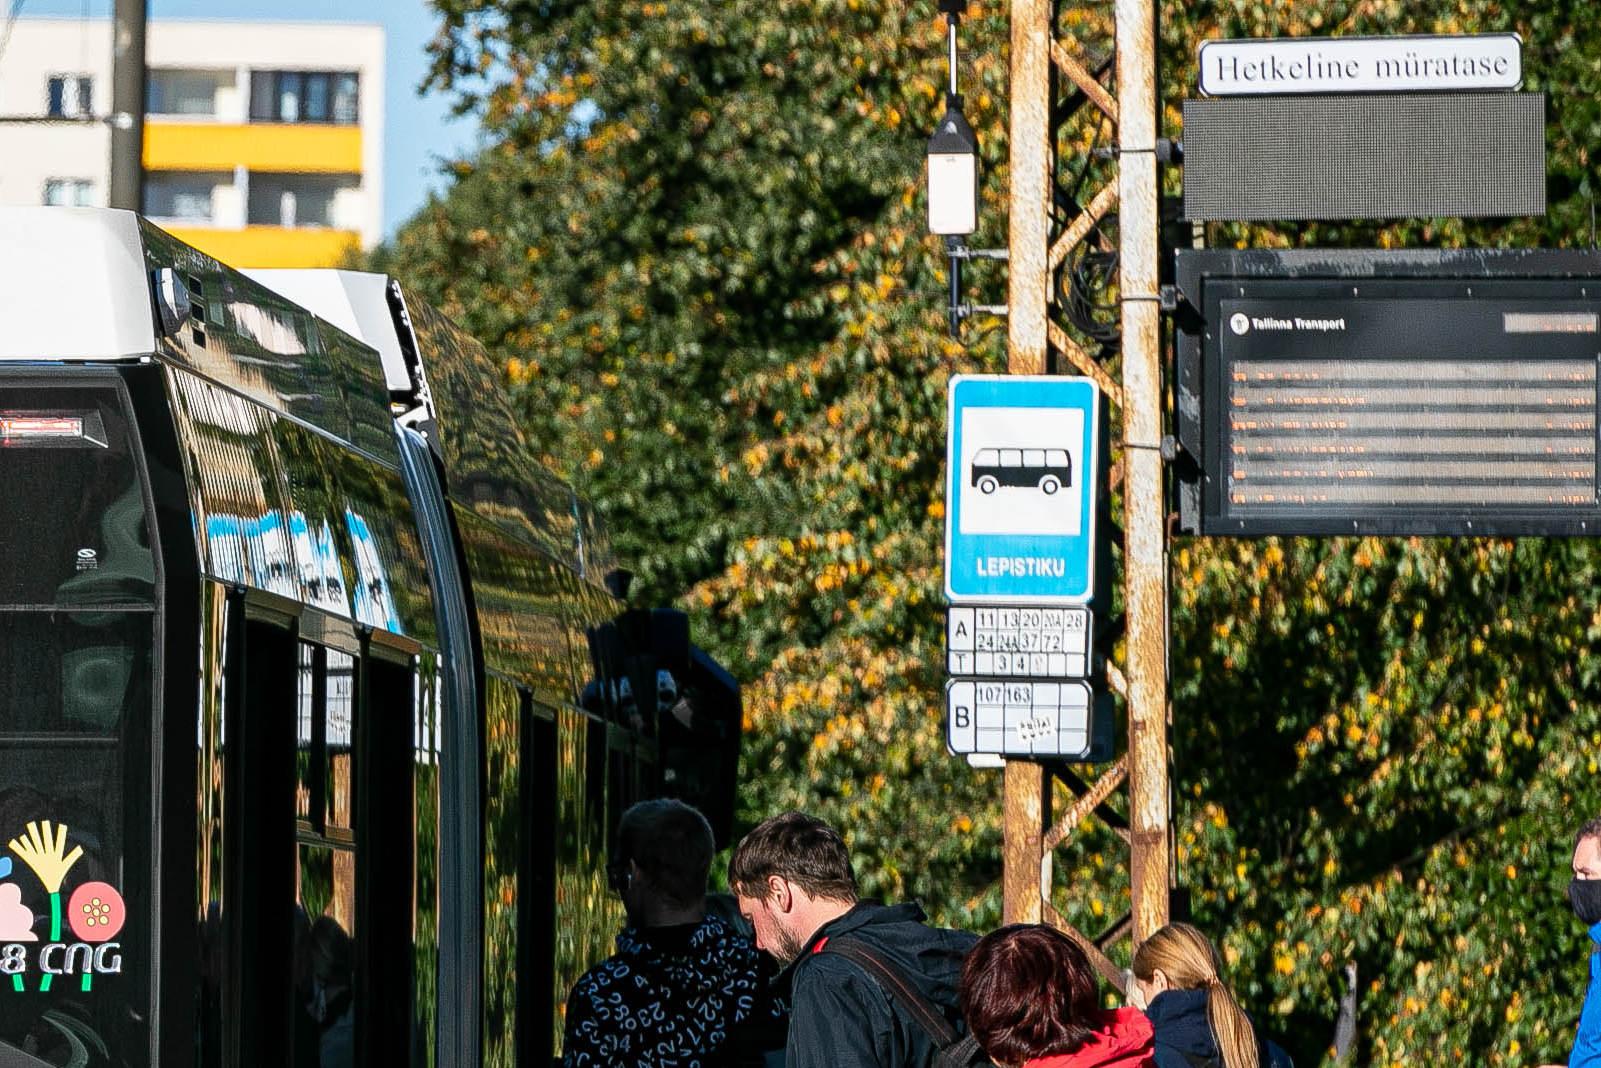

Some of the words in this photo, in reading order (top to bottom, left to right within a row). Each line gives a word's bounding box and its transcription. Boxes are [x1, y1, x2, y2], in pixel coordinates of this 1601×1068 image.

[1217, 51, 1360, 81] Hetkeline
[1375, 52, 1509, 77] müratase
[1251, 317, 1292, 331] Tallinna
[1294, 317, 1346, 332] Transport
[976, 556, 1066, 577] LEPISTIKU
[955, 621, 968, 637] A
[979, 611, 994, 627] 11
[1003, 611, 1019, 628] 13
[1022, 612, 1040, 628] 20
[1066, 613, 1083, 629] 28
[978, 633, 994, 651] 24
[1022, 633, 1039, 648] 37
[1044, 634, 1060, 649] 72
[956, 653, 968, 673] T
[998, 654, 1008, 670] 3
[978, 687, 1001, 703] 107
[1006, 687, 1031, 704] 163
[955, 706, 970, 728] B
[39, 942, 122, 974] CNG
